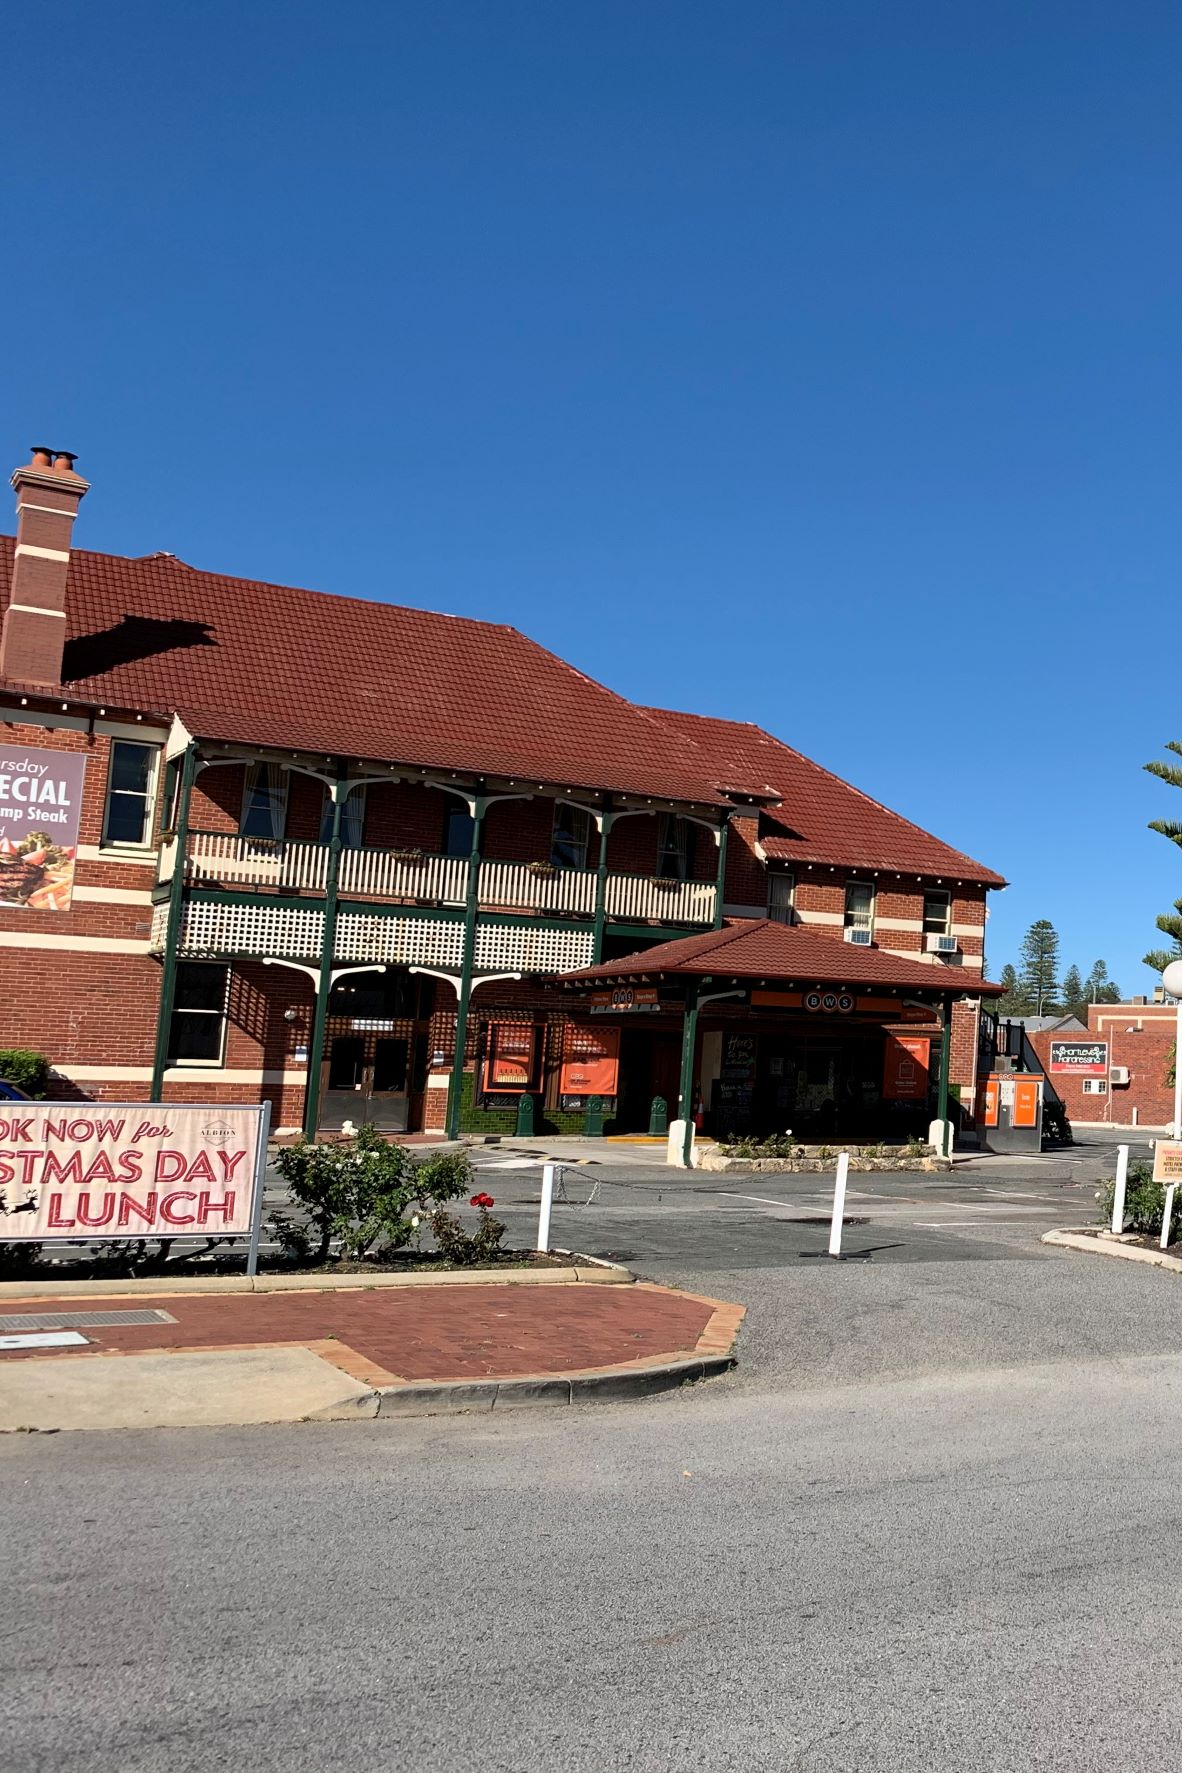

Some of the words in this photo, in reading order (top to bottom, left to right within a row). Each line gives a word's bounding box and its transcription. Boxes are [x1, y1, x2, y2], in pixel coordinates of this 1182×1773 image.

[27, 806, 68, 824] Steak
[41, 1118, 125, 1143] NOW
[131, 1121, 174, 1143] for
[200, 1128, 236, 1136] ALBION
[154, 1150, 247, 1183] DAY
[47, 1190, 236, 1228] LUNCH
